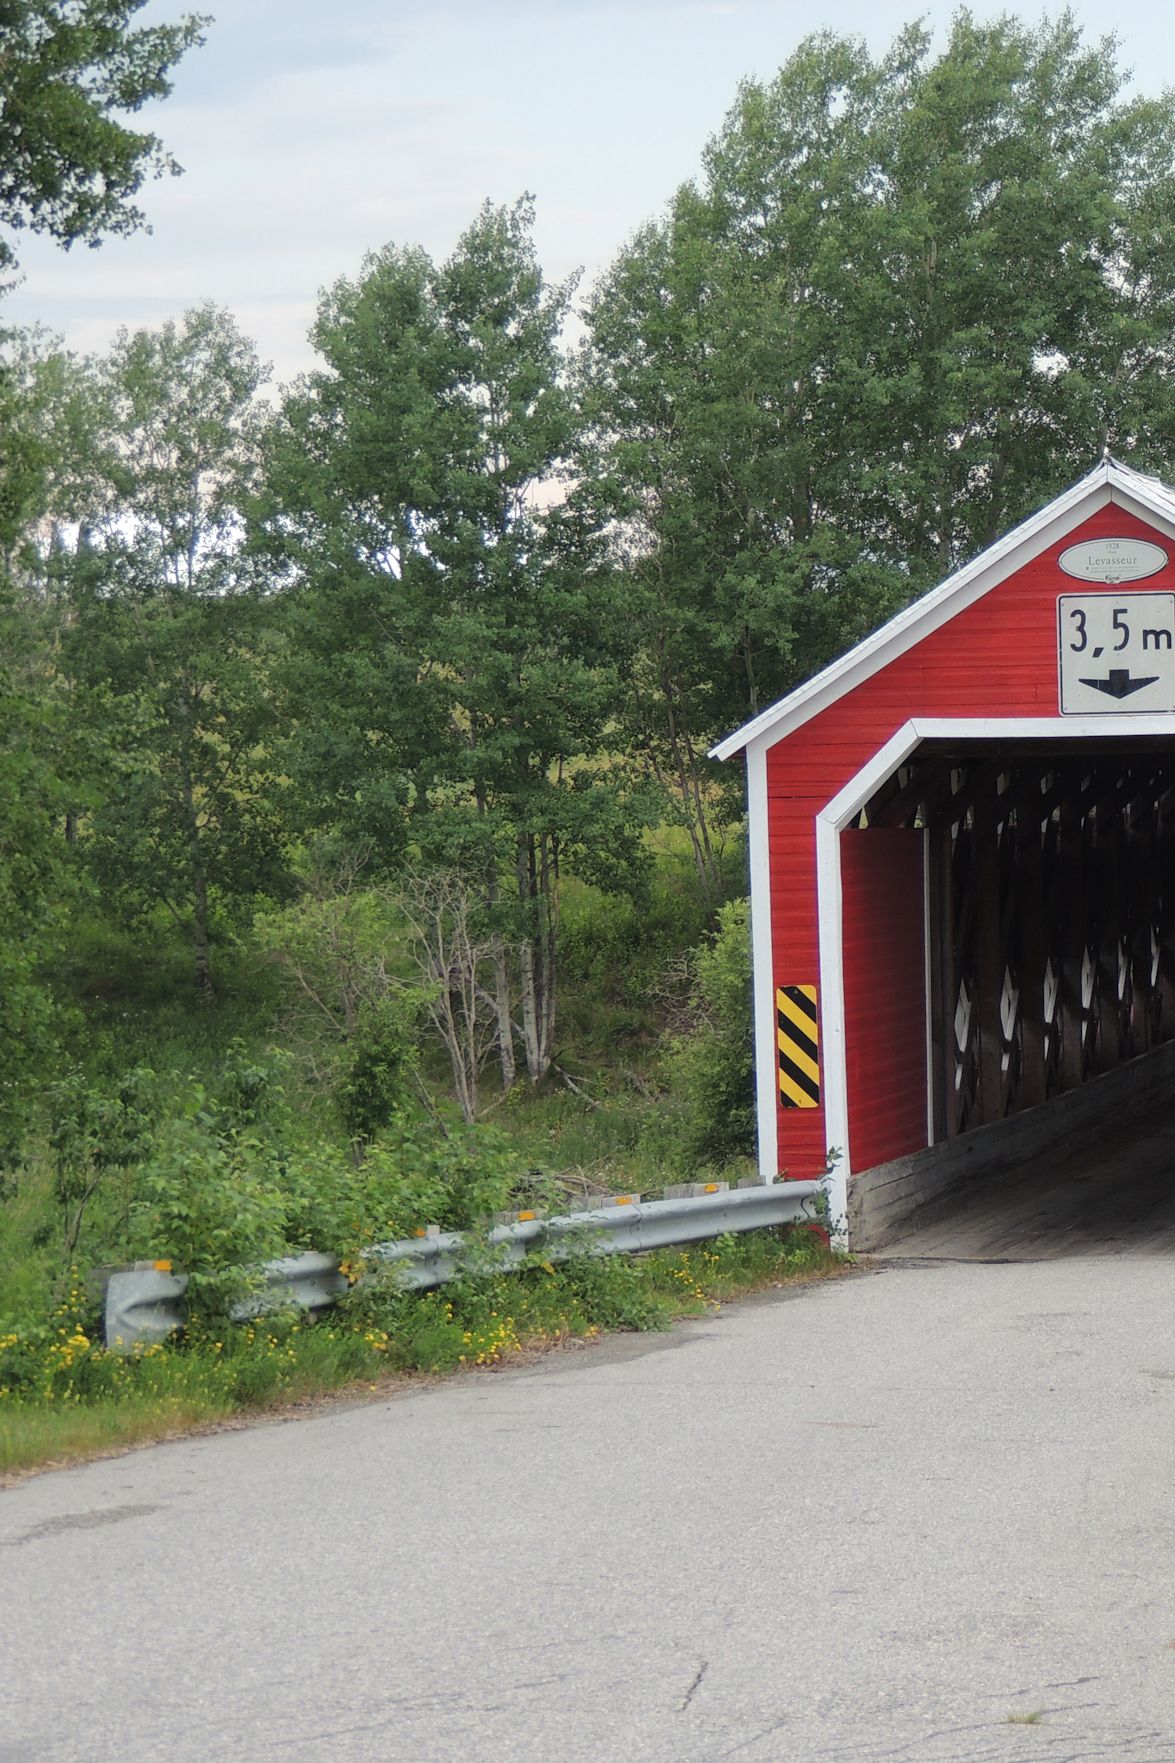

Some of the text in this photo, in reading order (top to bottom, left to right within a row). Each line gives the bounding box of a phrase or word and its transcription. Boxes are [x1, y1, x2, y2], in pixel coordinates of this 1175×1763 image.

[1088, 556, 1137, 566] Levasseur
[1070, 608, 1172, 658] 3,5 m
